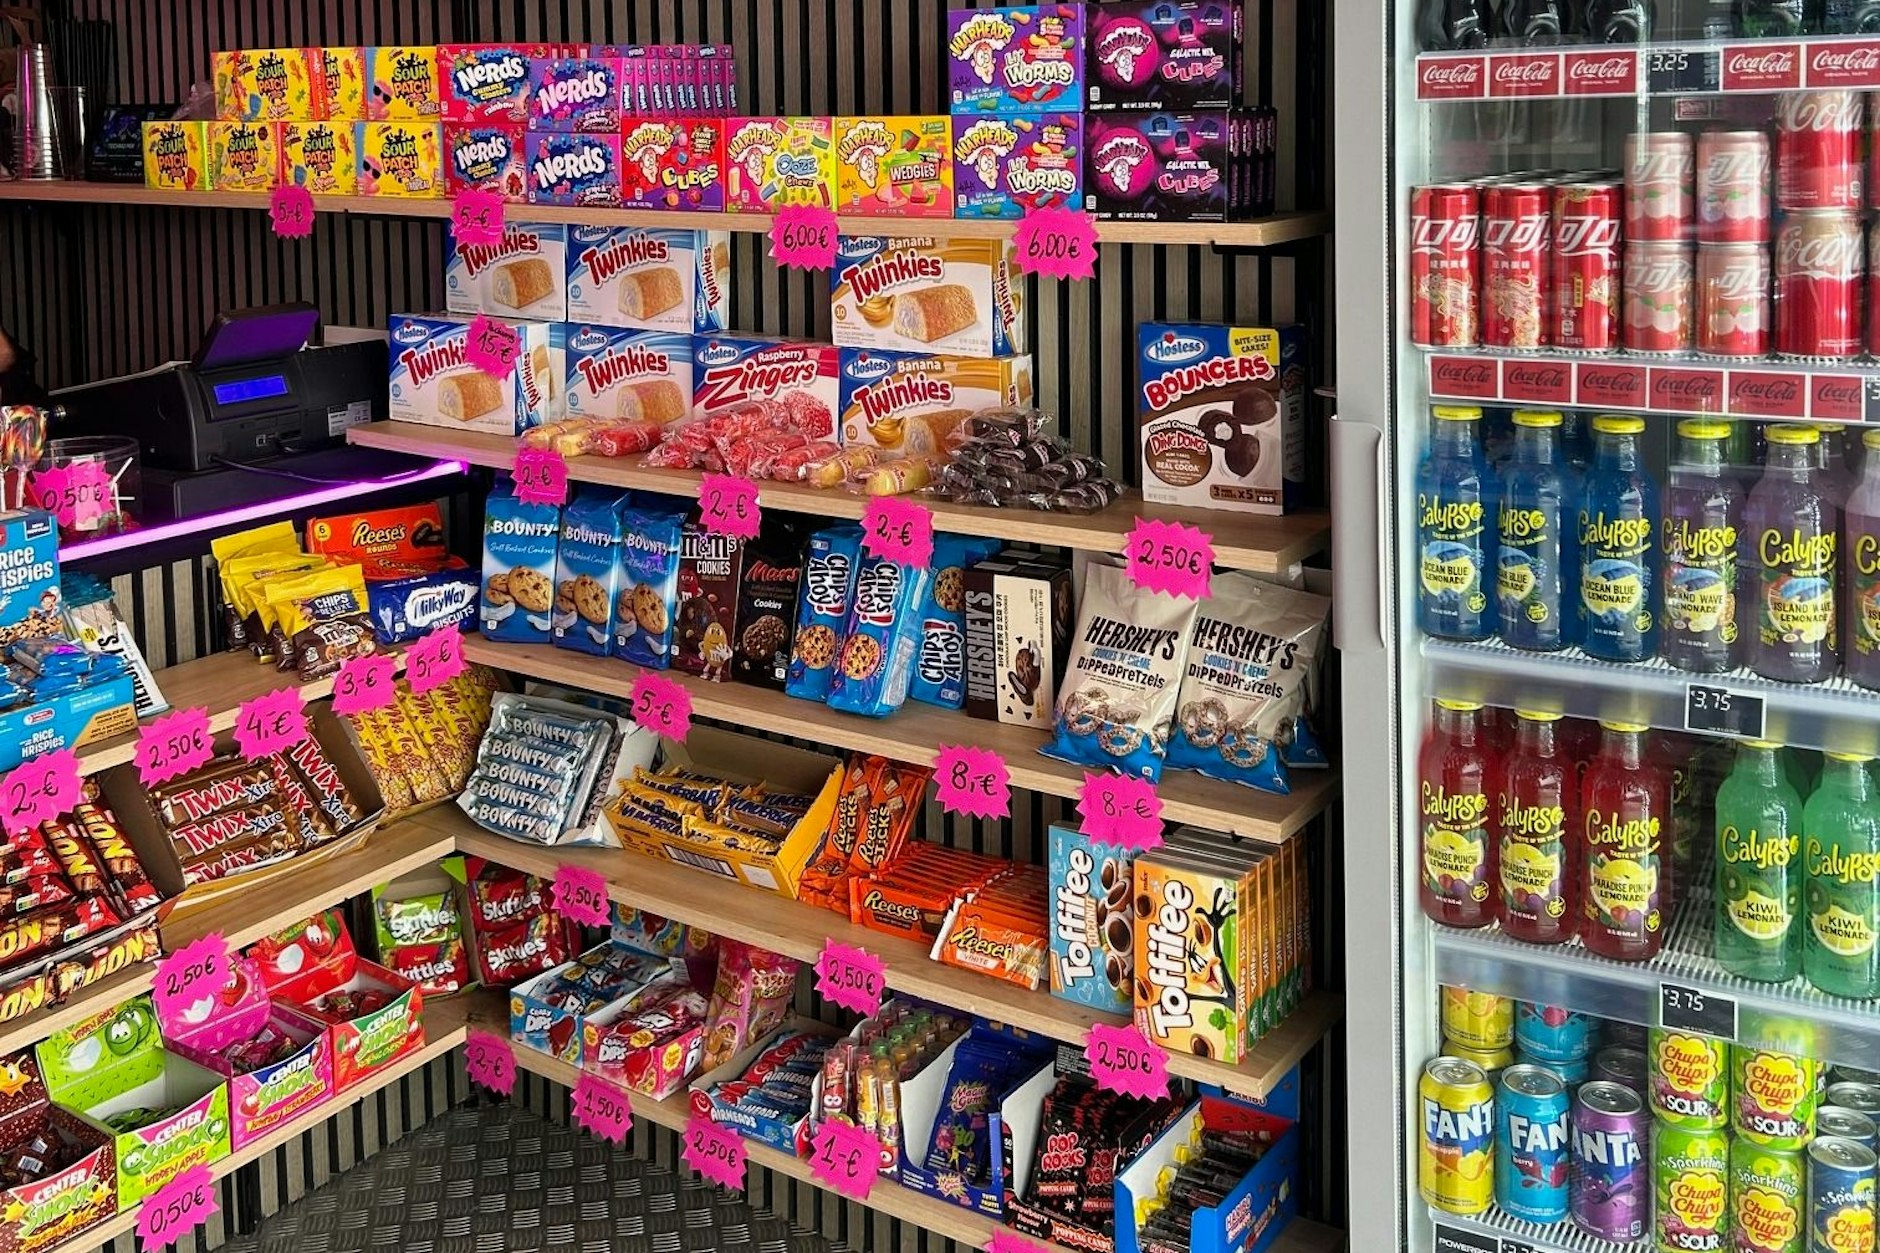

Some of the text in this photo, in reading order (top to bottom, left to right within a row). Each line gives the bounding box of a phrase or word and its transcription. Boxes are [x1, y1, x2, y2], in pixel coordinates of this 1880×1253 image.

[1170, 48, 1197, 58] GALACTIC
[1651, 54, 1688, 72] 3.25
[257, 64, 285, 79] SOUR
[394, 65, 428, 81] SOUR
[1007, 63, 1073, 85] WORMS
[1161, 54, 1224, 82] CUBES
[1423, 59, 1481, 84] Coca-Cola
[1496, 58, 1552, 82] Coca-Cola
[257, 78, 288, 92] PATCH
[393, 79, 430, 94] PATCH
[157, 138, 185, 153] SOUR
[229, 138, 256, 152] SOUR
[305, 137, 334, 152] SOUR
[624, 128, 674, 157] WARHEADS
[157, 153, 187, 166] PATCH
[229, 152, 259, 165] PATCH
[304, 152, 335, 165] PATCH
[382, 155, 417, 170] PATCH
[661, 164, 719, 190] CUBES
[891, 164, 936, 182] WEDGIES
[1010, 171, 1075, 192] WORMS
[783, 224, 829, 249] 6,00€
[888, 237, 932, 250] Banana
[1029, 227, 1081, 258] 6,00€
[582, 233, 667, 285] Twinkies
[399, 326, 429, 340] Hostess
[1234, 334, 1272, 346] BITE-SIZE
[703, 348, 737, 362] Hostess
[757, 350, 804, 363] Raspberry
[1241, 343, 1269, 352] CAKES!
[402, 341, 465, 386] Twinki
[579, 347, 667, 394] Twinkies
[898, 360, 941, 372] Banana
[705, 360, 817, 411] Zingers
[1146, 356, 1270, 408] BOUNCERS
[522, 465, 551, 489] 2,-€
[1175, 462, 1200, 472] COCOA
[42, 482, 104, 513] 0,50€
[710, 490, 748, 521] 2,-€
[1418, 494, 1484, 531] Calypso
[353, 521, 406, 547] Reese's
[493, 520, 552, 537] BOUNTY
[566, 527, 612, 548] BOUNTY
[877, 514, 913, 547] 2,-€
[1577, 510, 1650, 549] Calypso
[365, 543, 398, 554] ROUNDS
[1138, 539, 1203, 575] 2,50€
[697, 561, 731, 575] COOKIES
[746, 560, 799, 583] Mars
[1424, 562, 1468, 576] OCEAN BLUE
[1425, 573, 1465, 584] LEMONADE
[827, 554, 849, 605] Chips
[1614, 585, 1635, 595] BLUE
[314, 592, 349, 608] CHIPS
[415, 587, 467, 619] Milky Way
[754, 598, 783, 610] Cookies
[1587, 591, 1632, 603] LEMONADE
[1700, 594, 1723, 604] WAVE
[1772, 601, 1808, 614] ISLAND
[320, 603, 353, 616] DELUXE
[432, 604, 475, 630] BISCUITS
[1780, 613, 1827, 622] LEMONADE
[966, 590, 995, 702] HERSHEY'S
[1084, 615, 1180, 662] HERSHEY'S
[415, 640, 451, 677] 5,-€
[341, 667, 377, 695] 3,-€
[638, 689, 674, 726] 5,-€
[150, 728, 205, 769] 2,50€
[952, 760, 997, 796] 8,-€
[11, 770, 59, 817] 2,-€
[173, 776, 276, 819] Twix Xtra
[1103, 791, 1153, 818] 8,-€
[175, 810, 251, 855] Twix
[845, 795, 857, 854] STICKS
[1453, 855, 1477, 865] PUNCH
[1528, 869, 1553, 878] PUNCH
[563, 881, 602, 913] 2,50€
[864, 891, 920, 922] Reese's
[1746, 901, 1779, 914] KIWI
[1061, 849, 1095, 987] Toffifee
[1084, 897, 1100, 948] COCONUT
[1828, 916, 1861, 930] KIWI
[398, 959, 455, 981] kittles
[962, 952, 989, 966] WHITE
[1147, 880, 1193, 1038] Toffifee
[166, 956, 216, 997] 2,50€
[829, 959, 876, 996] 2,50€
[525, 1014, 552, 1032] DIPS
[477, 1048, 503, 1078] 2,-€
[1098, 1042, 1154, 1074] 2,50€
[1664, 1045, 1710, 1066] Chupa
[268, 1052, 311, 1084] CENTER
[1662, 1060, 1708, 1081] Chups
[1752, 1066, 1798, 1084] Chupa
[1750, 1082, 1798, 1100] Chups
[584, 1095, 624, 1125] 1,50€
[711, 1107, 757, 1128] AIRHEADS
[155, 1109, 203, 1144] CENTER
[142, 1118, 214, 1173] SHOCK
[693, 1131, 737, 1169] 2,50€
[1047, 1134, 1078, 1152] POP
[178, 1149, 207, 1172] APPLE
[821, 1136, 861, 1177] 1,-€
[1042, 1148, 1085, 1172] ROCKS
[1512, 1156, 1534, 1168] berry
[1669, 1152, 1726, 1172] Sparkling
[34, 1169, 87, 1204] CENTER
[1677, 1184, 1721, 1200] Chupa
[150, 1185, 206, 1234] 0,50€
[1008, 1201, 1048, 1224] Strawberry
[1018, 1214, 1040, 1227] Flavour
[1056, 1227, 1087, 1242] POPPING
